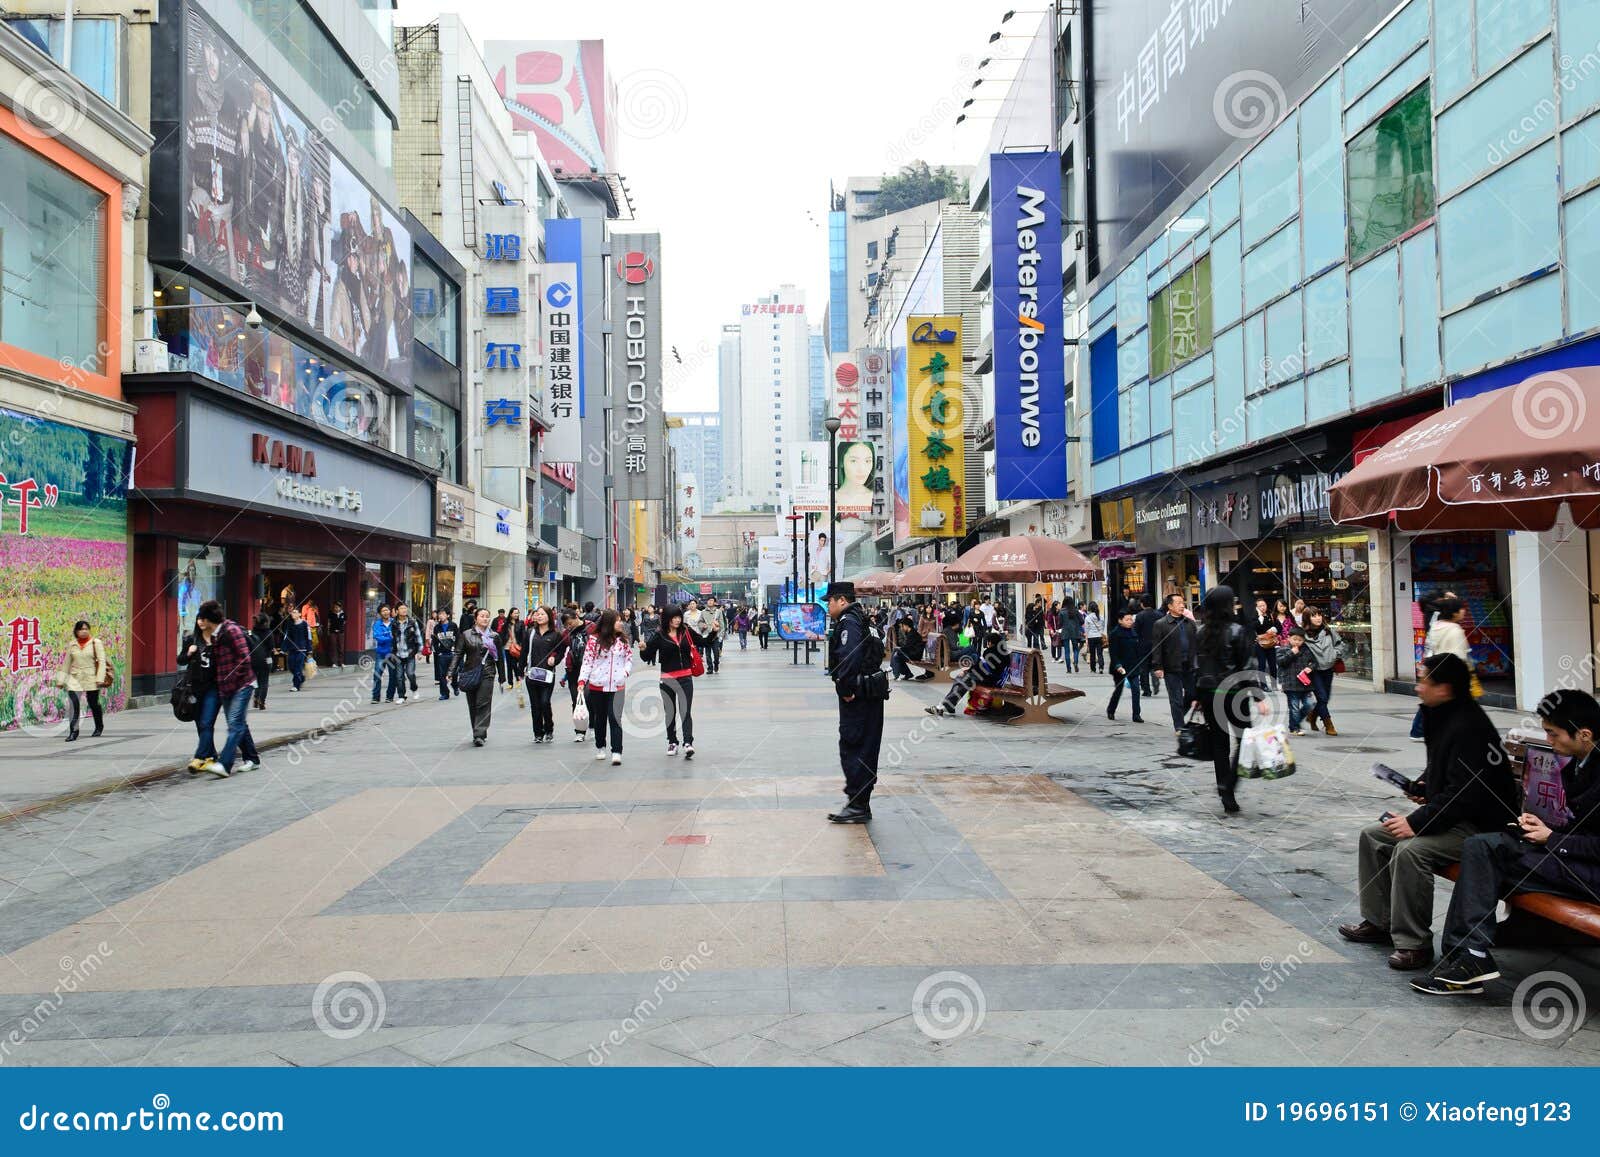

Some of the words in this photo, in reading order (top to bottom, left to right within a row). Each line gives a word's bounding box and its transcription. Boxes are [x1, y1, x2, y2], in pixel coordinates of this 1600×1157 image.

[1117, 0, 1231, 144] 中国高端
[485, 233, 521, 426] 鸿星尔克
[550, 312, 573, 418] 中国建设银行
[625, 434, 647, 472] 高邦
[1161, 500, 1188, 519] collection
